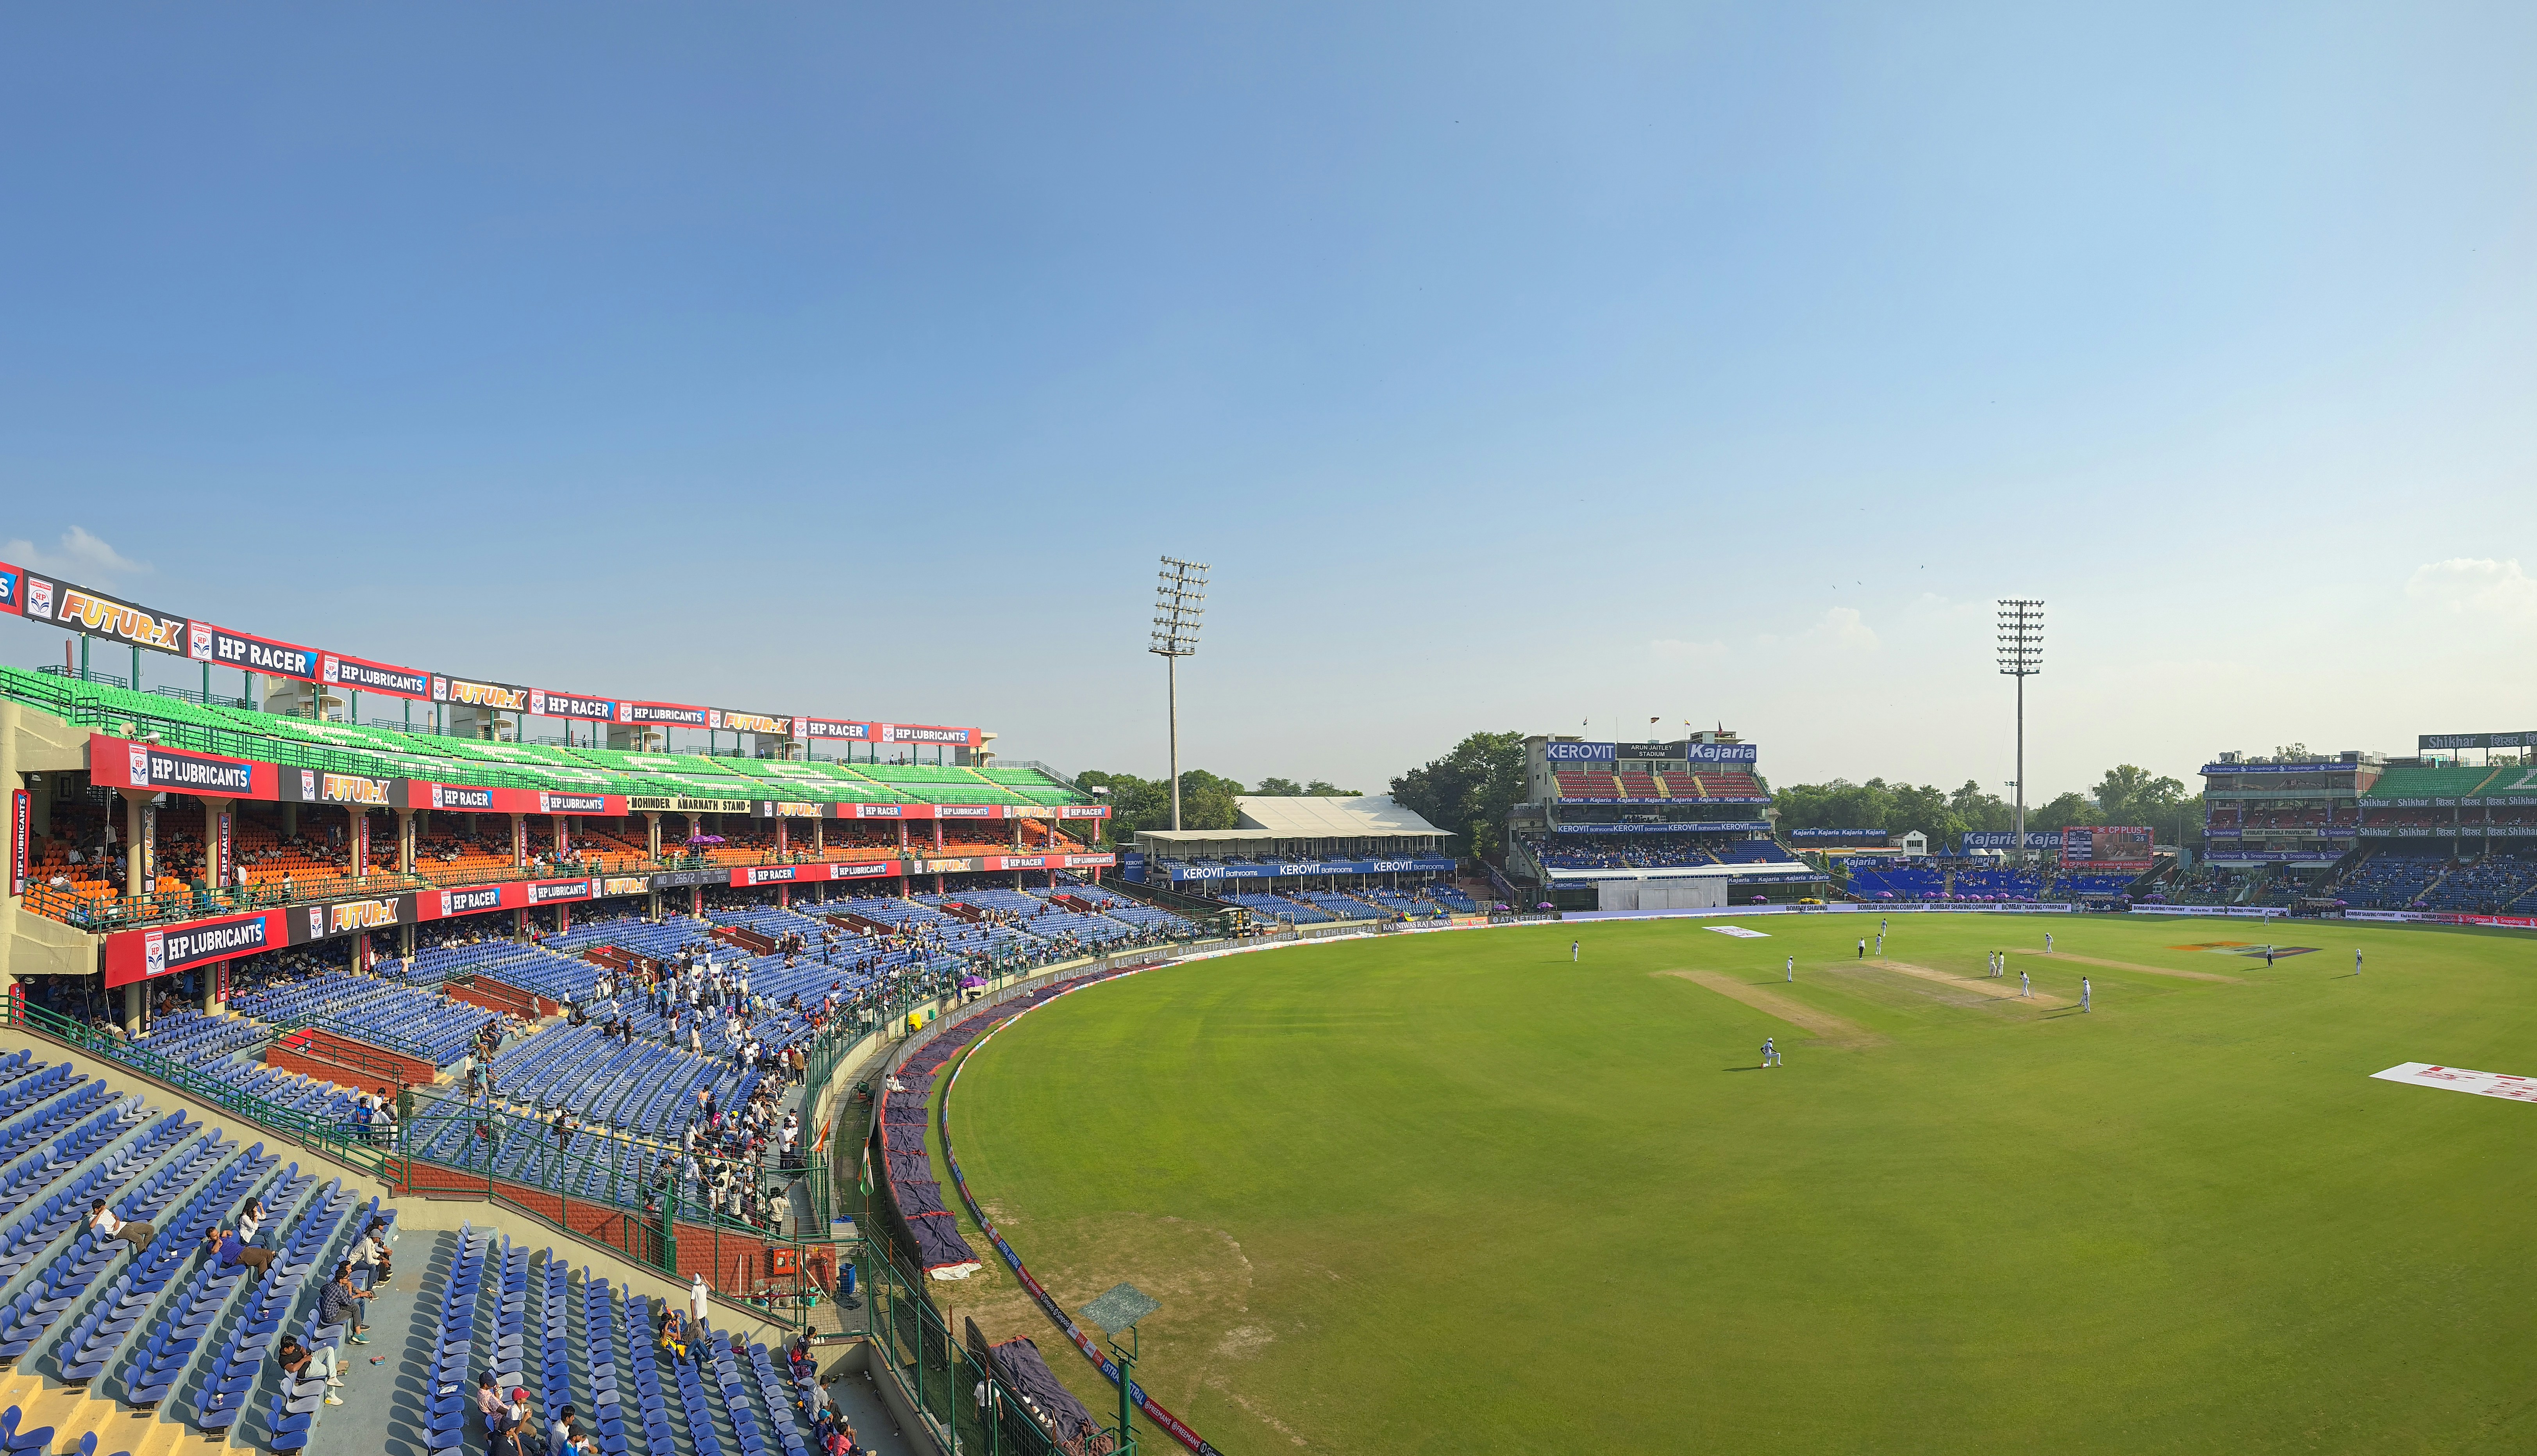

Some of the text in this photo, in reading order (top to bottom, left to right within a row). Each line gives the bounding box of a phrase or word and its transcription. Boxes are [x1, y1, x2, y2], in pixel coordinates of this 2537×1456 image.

[60, 591, 182, 649] FUTUR-X
[218, 636, 306, 674] HP RACER
[341, 665, 423, 692] HP LUBRICANTS
[450, 681, 526, 709] FUTUR-X
[549, 697, 608, 717] HP RACER
[634, 708, 702, 722] HP LUBRICANTS
[724, 713, 790, 733] FUTUR-X
[810, 723, 863, 737] HP RACER
[896, 728, 965, 742] HP LUBRICANTS
[2429, 735, 2476, 748] Shikhar
[2490, 735, 2520, 746] शिखर
[1547, 744, 1614, 759] KEROVIT
[1690, 744, 1755, 762] Kajaria
[152, 757, 247, 788] HP LUBRICANTS
[323, 774, 390, 804] FUTUR-X
[445, 790, 488, 806] HP RACER
[550, 797, 602, 810] HP LUBRICANTS
[632, 797, 745, 811] MOHINDER AMARNATH STAND
[2359, 799, 2390, 807] Shikhar
[2398, 798, 2429, 807] Shikhar
[2436, 798, 2455, 806] शिखर
[2461, 797, 2481, 806] शिखर
[2486, 797, 2505, 806] शिखर
[777, 803, 824, 816] FUTUR-X
[866, 807, 898, 815] HP RACER
[1013, 807, 1055, 817] FUTUR-X
[2360, 828, 2391, 836] Shikhar
[2399, 828, 2430, 836] Shikhar
[2436, 828, 2457, 836] शिखर
[2462, 827, 2481, 836] शिखर
[2487, 827, 2507, 836] शिखर
[1965, 833, 2017, 847] Kajaria
[927, 859, 971, 873] FUTUR-X
[1280, 864, 1320, 875] KEROVIT
[1374, 861, 1413, 872] KEROVIT
[1843, 858, 1876, 867] Kajaria
[757, 869, 792, 881] HP RACER
[839, 865, 885, 875] HP LUBRICANTS
[1183, 867, 1225, 880] KEROVIT
[657, 875, 667, 884] IND
[675, 873, 695, 884] 266/2
[538, 884, 586, 898] HP LUBRICANTS
[604, 877, 650, 895] FUTUR-X
[453, 891, 496, 910] HP RACER
[330, 898, 399, 933] FUTUR-X
[1323, 925, 1376, 937] ATHLETIFREAK
[1383, 924, 1394, 932] RAJ
[1396, 922, 1416, 930] NIWAS
[1417, 921, 1429, 929] RAJ
[1431, 919, 1451, 927] NIWAS
[168, 923, 263, 961] HP LUBRICANTS
[1185, 940, 1238, 955] ATHLETIFREAK
[1059, 962, 1106, 982] ATHLETIFREAK
[1003, 977, 1045, 1001] ATHLETIFREAK
[951, 997, 991, 1026] ATHLETIFREAK
[902, 1023, 938, 1058] ATHLETIFREAK
[998, 1240, 1020, 1270] ASTRAL ASTRAL
[1043, 1296, 1055, 1312] Simpolo
[1056, 1311, 1071, 1328] Simpolo
[1077, 1335, 1085, 1345] VIDA
[1148, 1404, 1172, 1425] FREEMANS
[1176, 1425, 1201, 1448] FREEMANS
